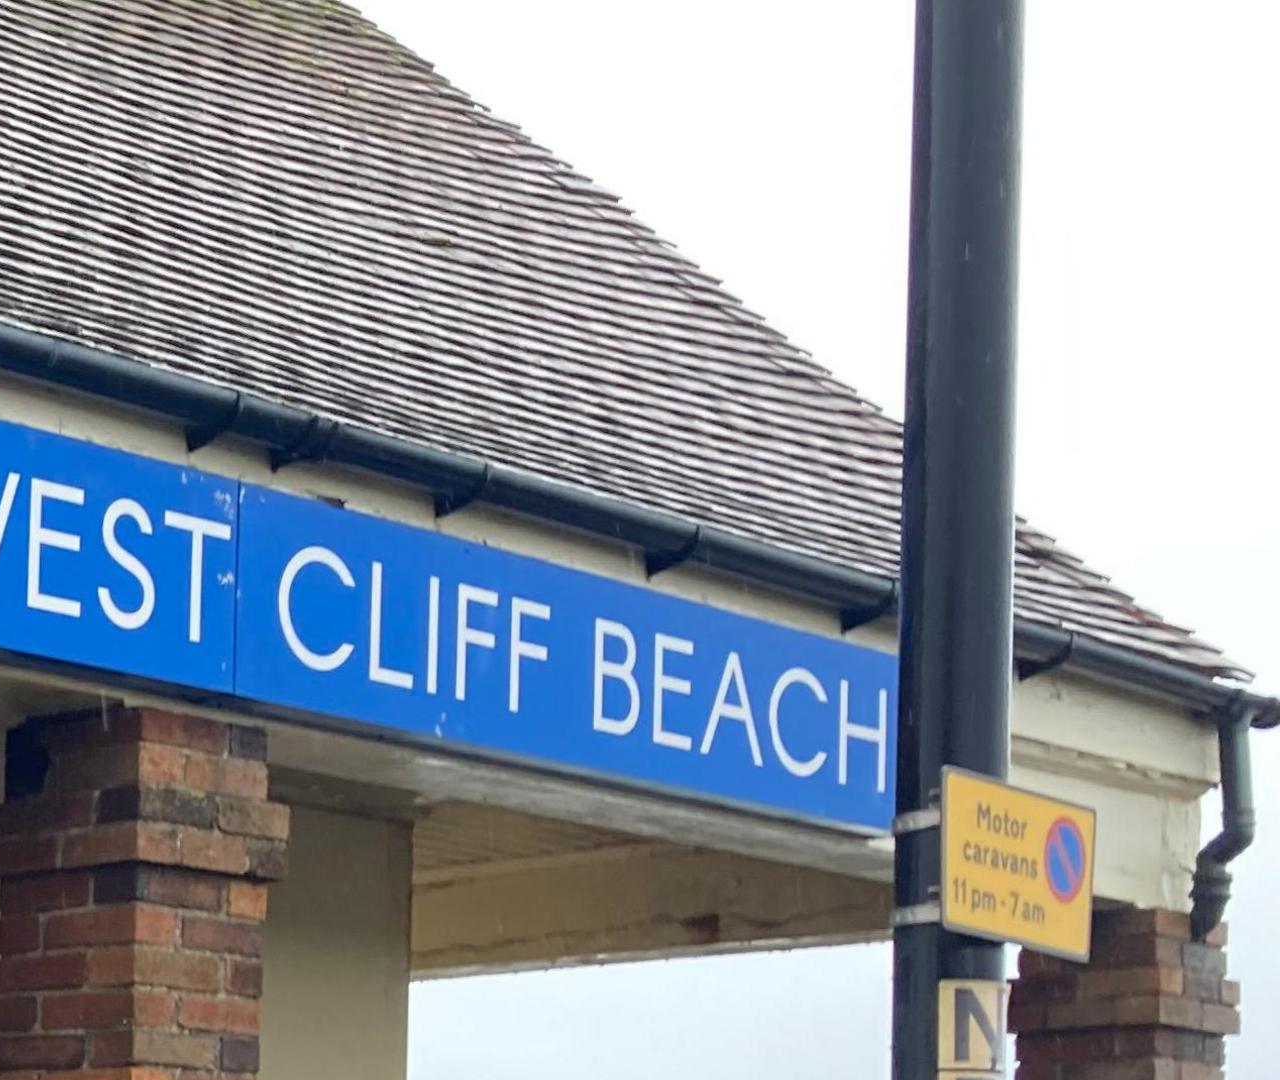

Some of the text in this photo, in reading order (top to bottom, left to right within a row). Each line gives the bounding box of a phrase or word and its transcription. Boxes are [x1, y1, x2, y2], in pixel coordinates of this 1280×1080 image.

[278, 546, 551, 713] CLIFF
[593, 617, 888, 794] BEACH
[976, 802, 1028, 841] Motor
[962, 840, 1039, 880] caravans
